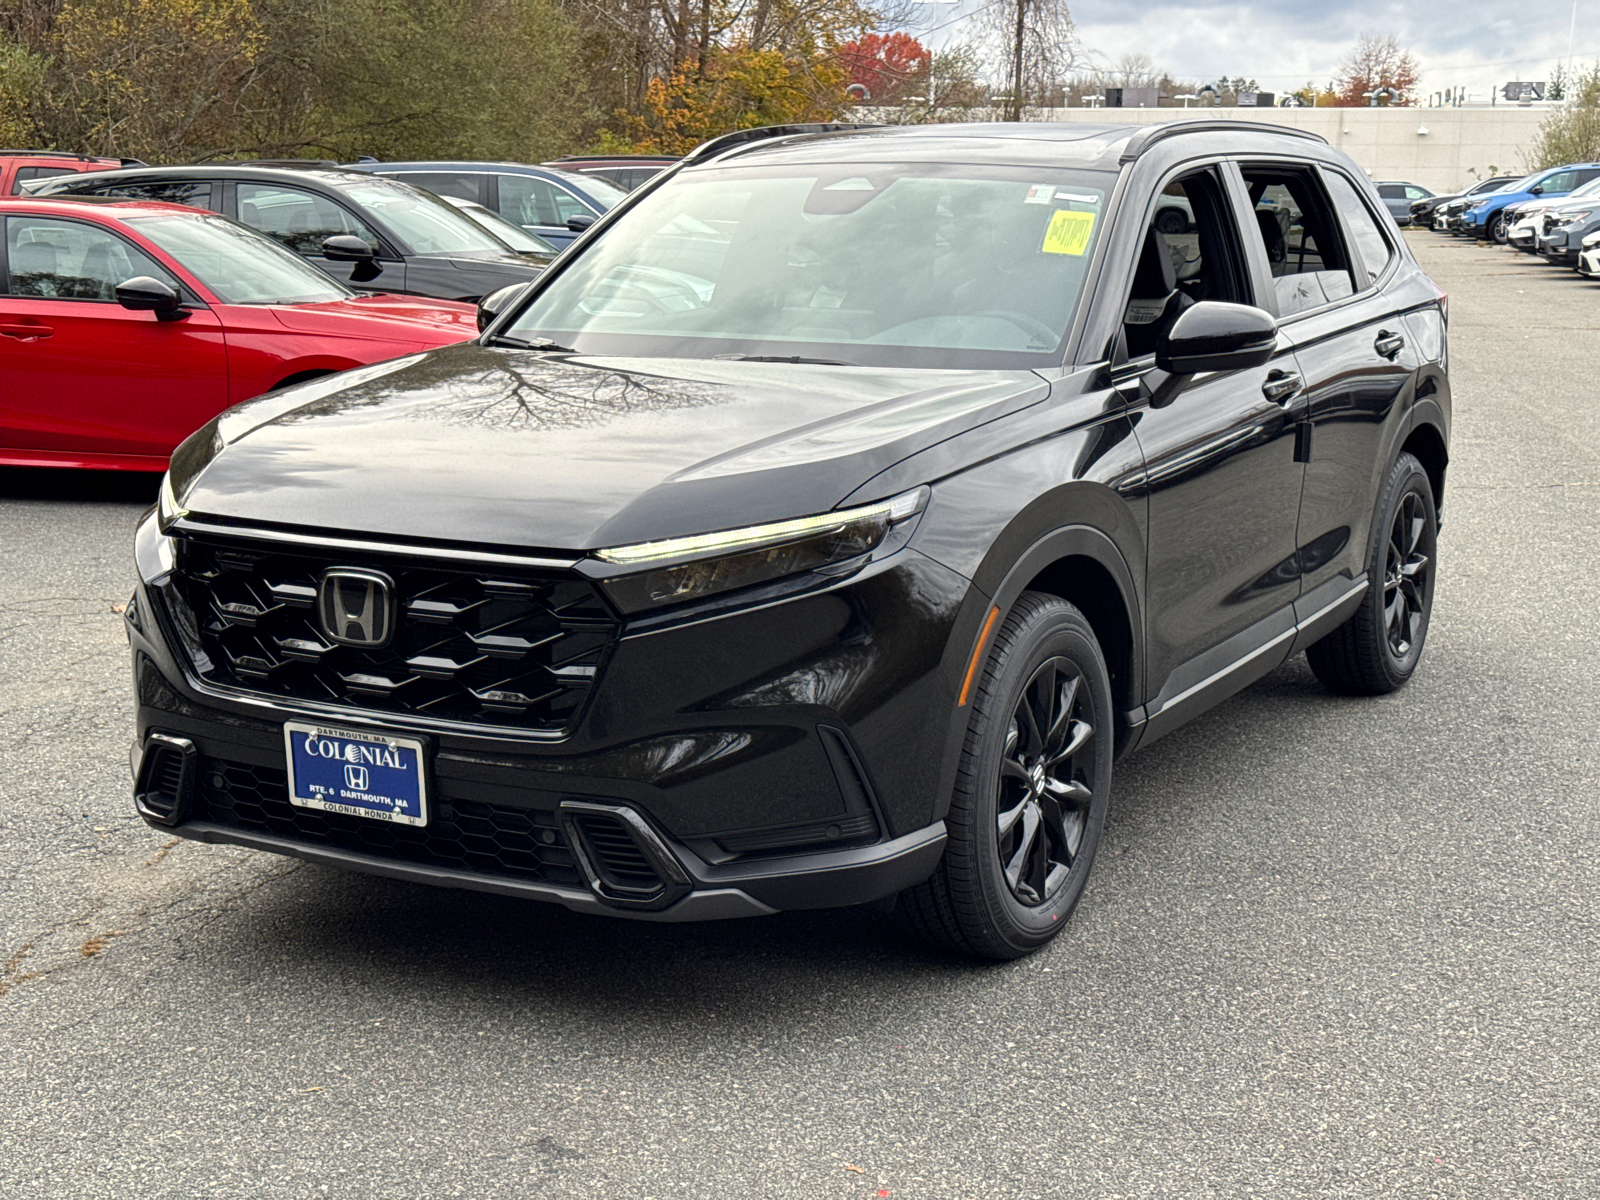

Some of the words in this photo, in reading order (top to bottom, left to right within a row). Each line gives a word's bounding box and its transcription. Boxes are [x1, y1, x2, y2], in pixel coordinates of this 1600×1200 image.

[373, 734, 388, 744] MA
[304, 737, 407, 770] COLONIAL
[309, 784, 328, 795] RTE.
[328, 787, 335, 796] 6
[340, 789, 394, 807] DARTMOUTH,
[395, 798, 409, 808] MA
[323, 802, 362, 816] COLONIAL
[364, 809, 393, 821] HONDA
